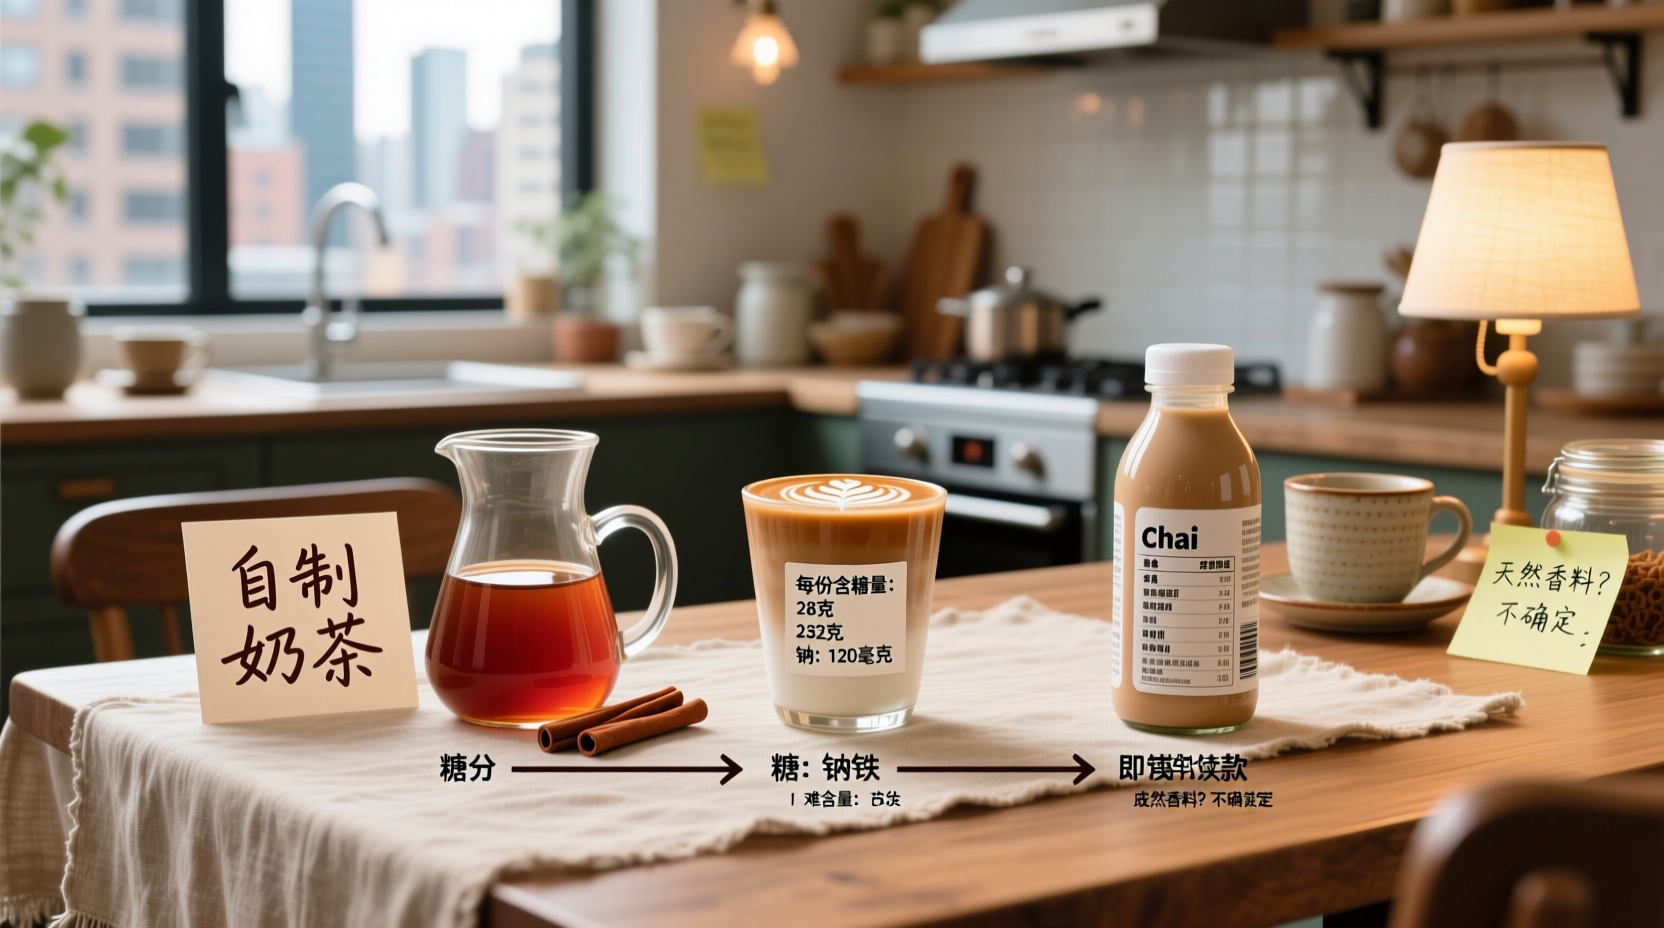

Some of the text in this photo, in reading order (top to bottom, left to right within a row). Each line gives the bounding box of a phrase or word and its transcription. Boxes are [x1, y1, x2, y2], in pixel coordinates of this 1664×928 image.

[1141, 525, 1199, 551] Chai
[231, 542, 359, 611] 自制
[1493, 561, 1611, 596] 天然香料？
[796, 598, 835, 618] 28克
[221, 612, 384, 688] 奶茶
